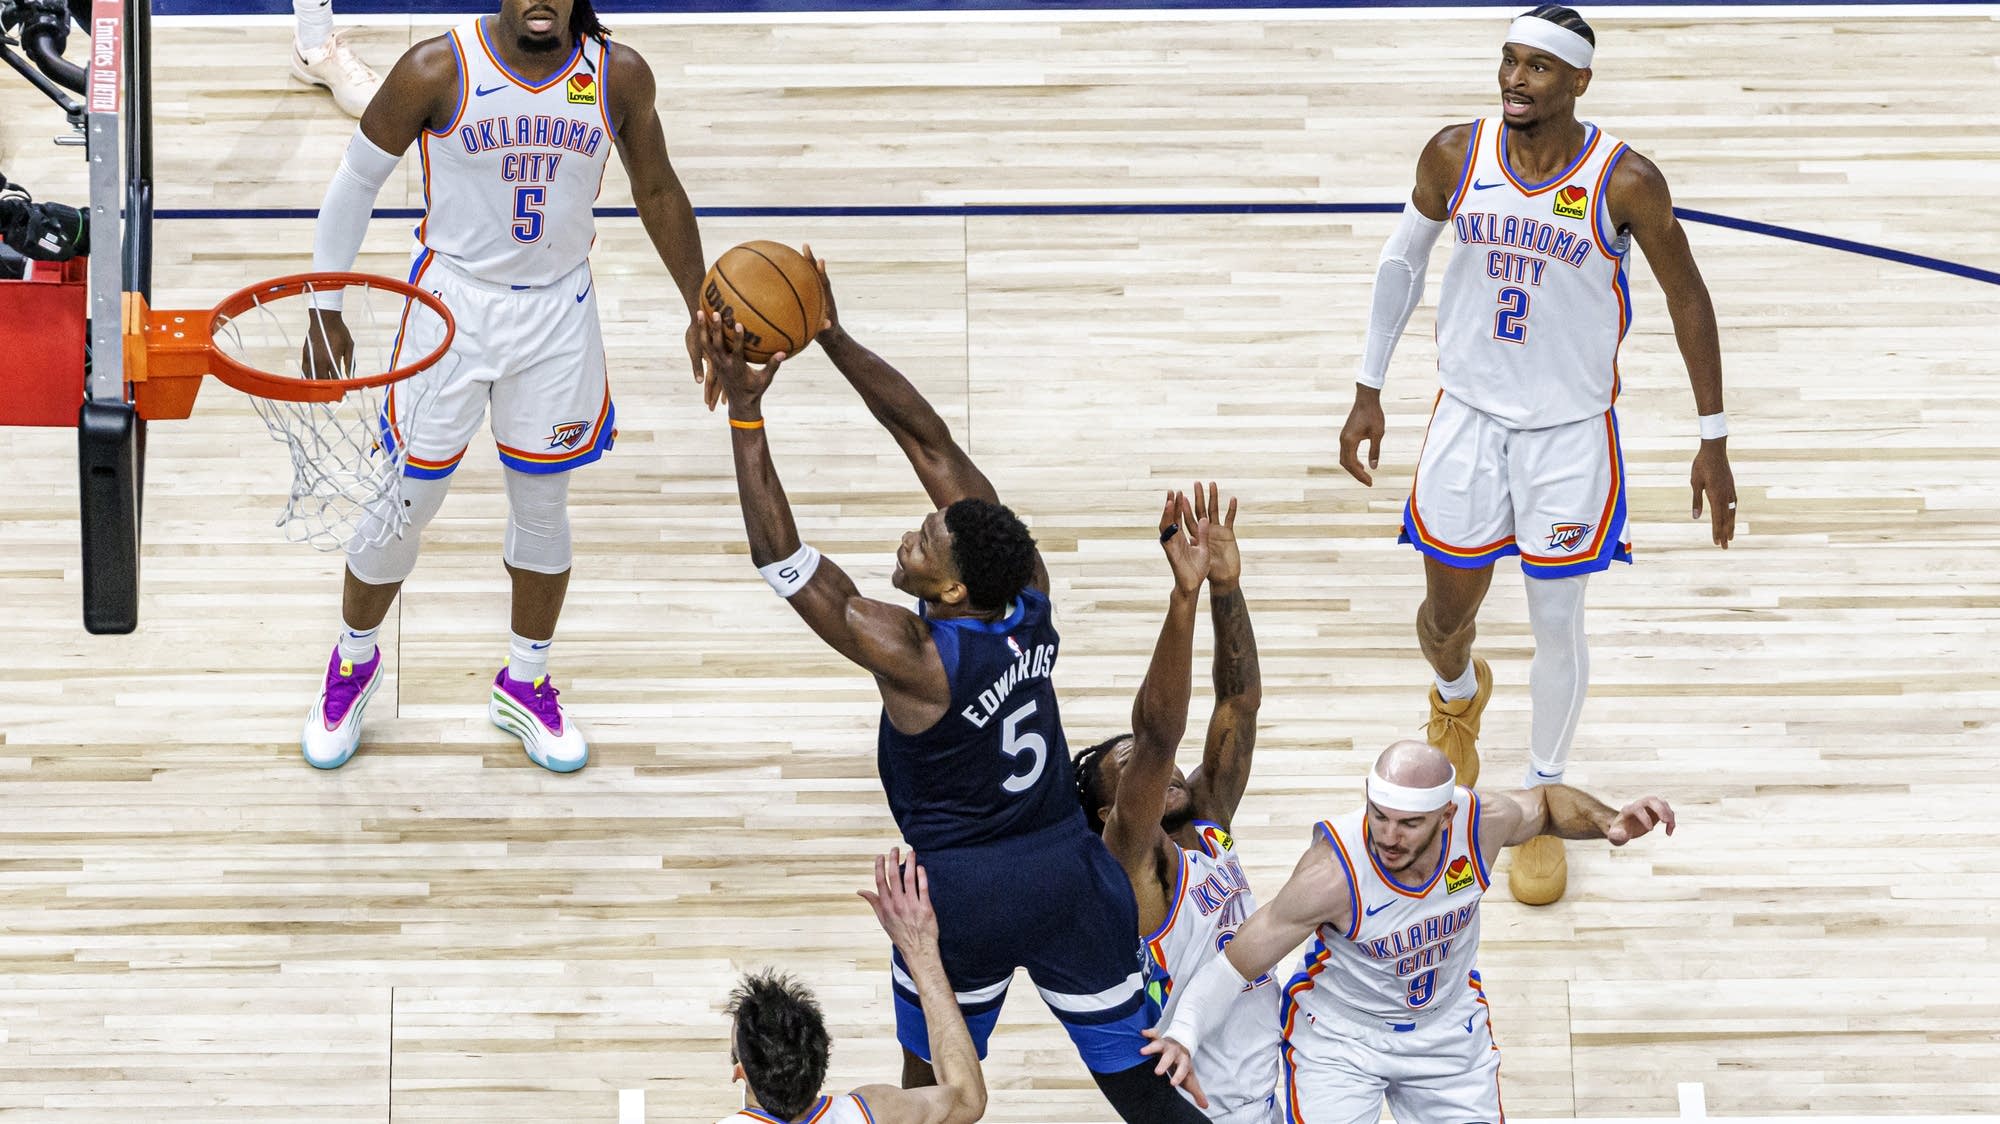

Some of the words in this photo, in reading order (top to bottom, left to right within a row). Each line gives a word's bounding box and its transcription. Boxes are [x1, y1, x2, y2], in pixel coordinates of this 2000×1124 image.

[95, 18, 119, 67] Emirates
[93, 83, 116, 110] BETTER
[94, 70, 117, 83] FLY
[460, 115, 603, 157] OKLAHOMA
[502, 153, 562, 182] CITY
[512, 186, 546, 243] 5
[1455, 213, 1593, 268] OKLAHOMA
[1487, 251, 1547, 286] CITY
[1493, 287, 1531, 344] 2
[551, 426, 582, 446] OKC
[1550, 528, 1581, 546] OKC
[779, 566, 800, 584] 5
[961, 644, 1054, 728] EDWARDS
[1002, 699, 1047, 792] 5
[1357, 902, 1474, 960] OKLAHOM
[1396, 938, 1454, 977] CITY
[1406, 967, 1438, 1009] 9
